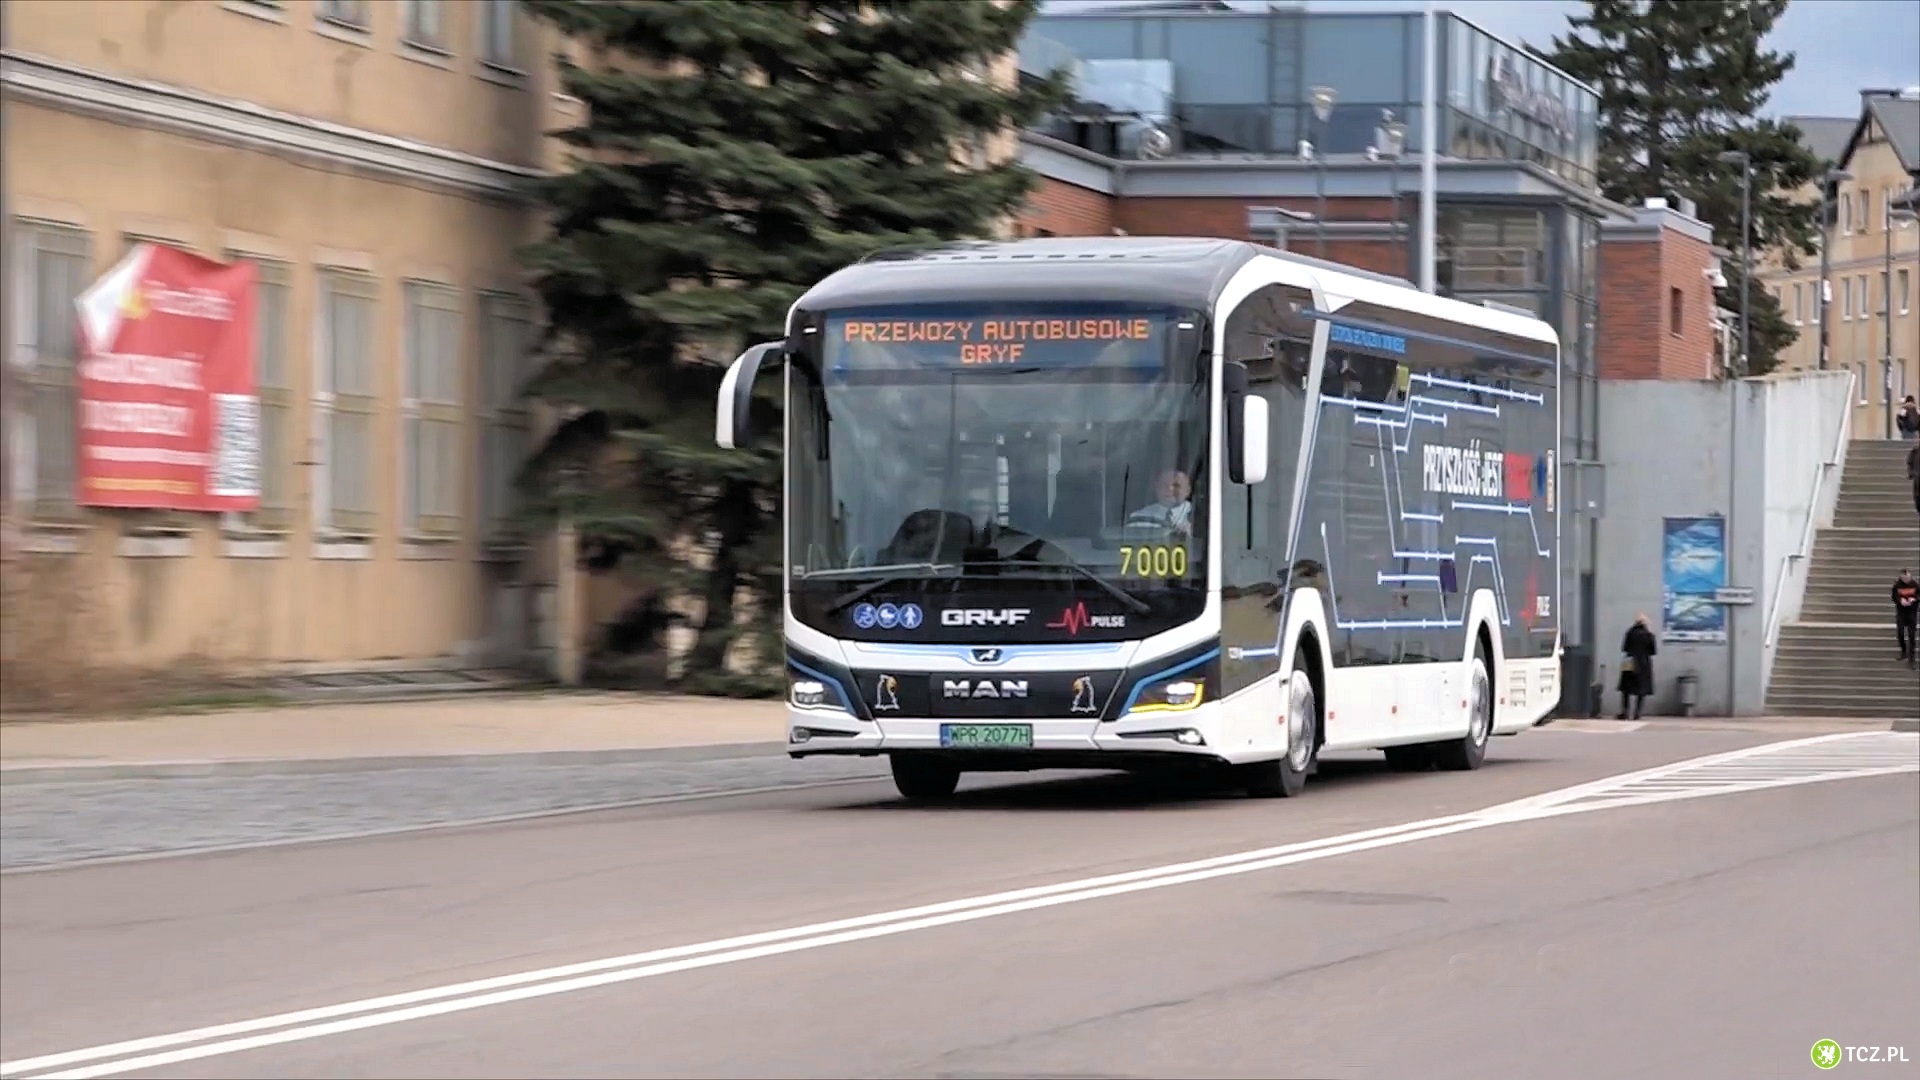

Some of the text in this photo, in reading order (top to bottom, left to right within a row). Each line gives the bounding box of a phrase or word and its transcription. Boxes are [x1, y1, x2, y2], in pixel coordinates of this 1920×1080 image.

[844, 319, 1150, 343] PRZEWOZY AUTOBUSOWE
[960, 343, 1025, 364] GRYF
[1483, 451, 1504, 497] JEST
[1119, 546, 1187, 577] 7000
[941, 608, 1031, 626] GRYF
[1091, 614, 1126, 628] PULSE
[943, 680, 1029, 698] MAN
[950, 727, 1029, 742] WPR 2077H
